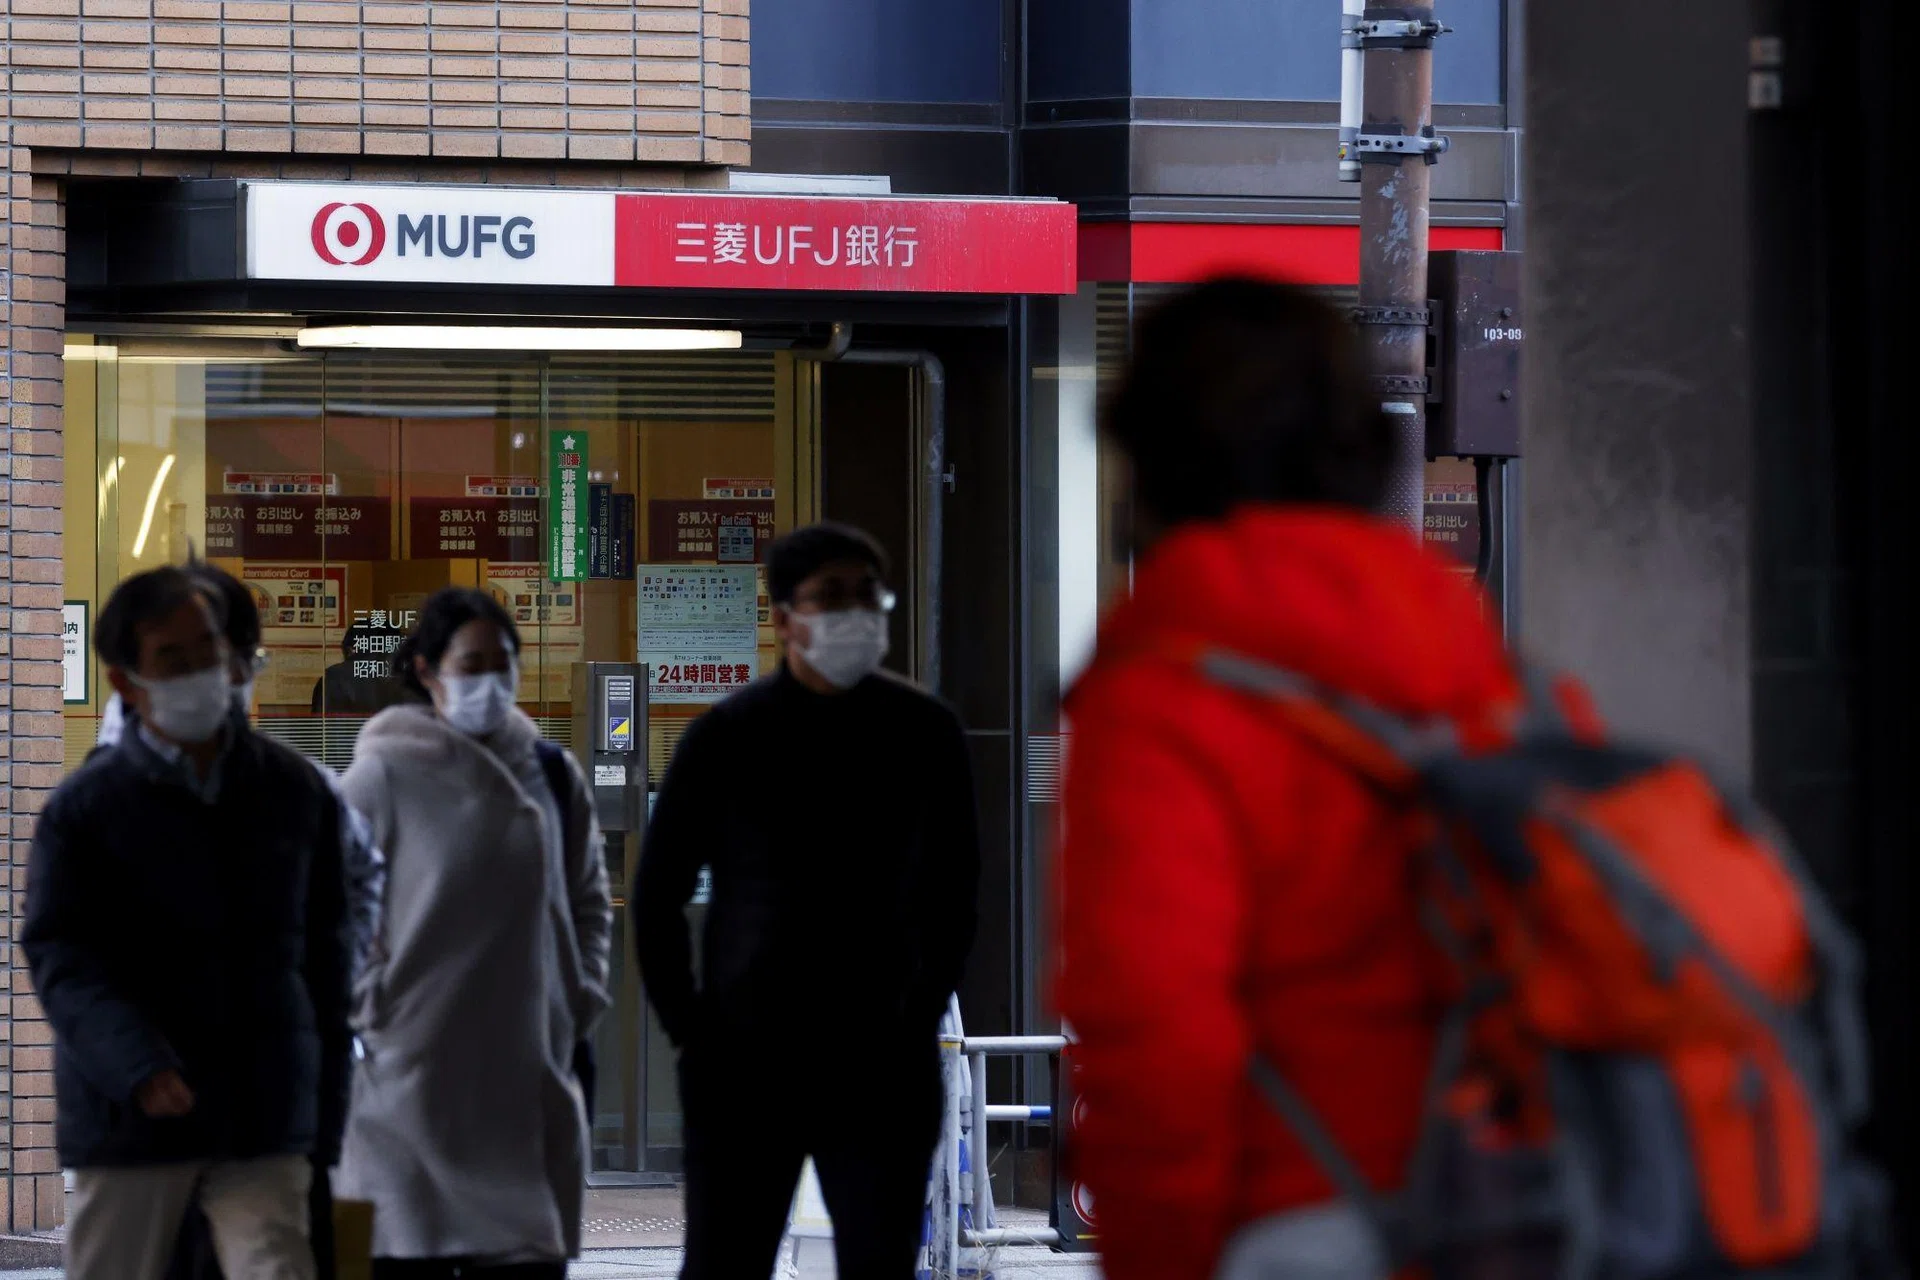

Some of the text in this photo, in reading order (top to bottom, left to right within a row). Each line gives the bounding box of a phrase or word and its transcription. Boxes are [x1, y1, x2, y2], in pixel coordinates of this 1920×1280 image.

[397, 213, 536, 259] MUFG
[675, 222, 919, 267] 三菱UFJ銀行
[204, 506, 362, 520] 預入れ お引出し お振込み
[440, 509, 539, 522] お預入れ お引出し
[1424, 515, 1468, 528] お引出し
[290, 568, 309, 578] Card
[353, 610, 418, 629] 三菱UF
[658, 664, 750, 684] 24時間営業
